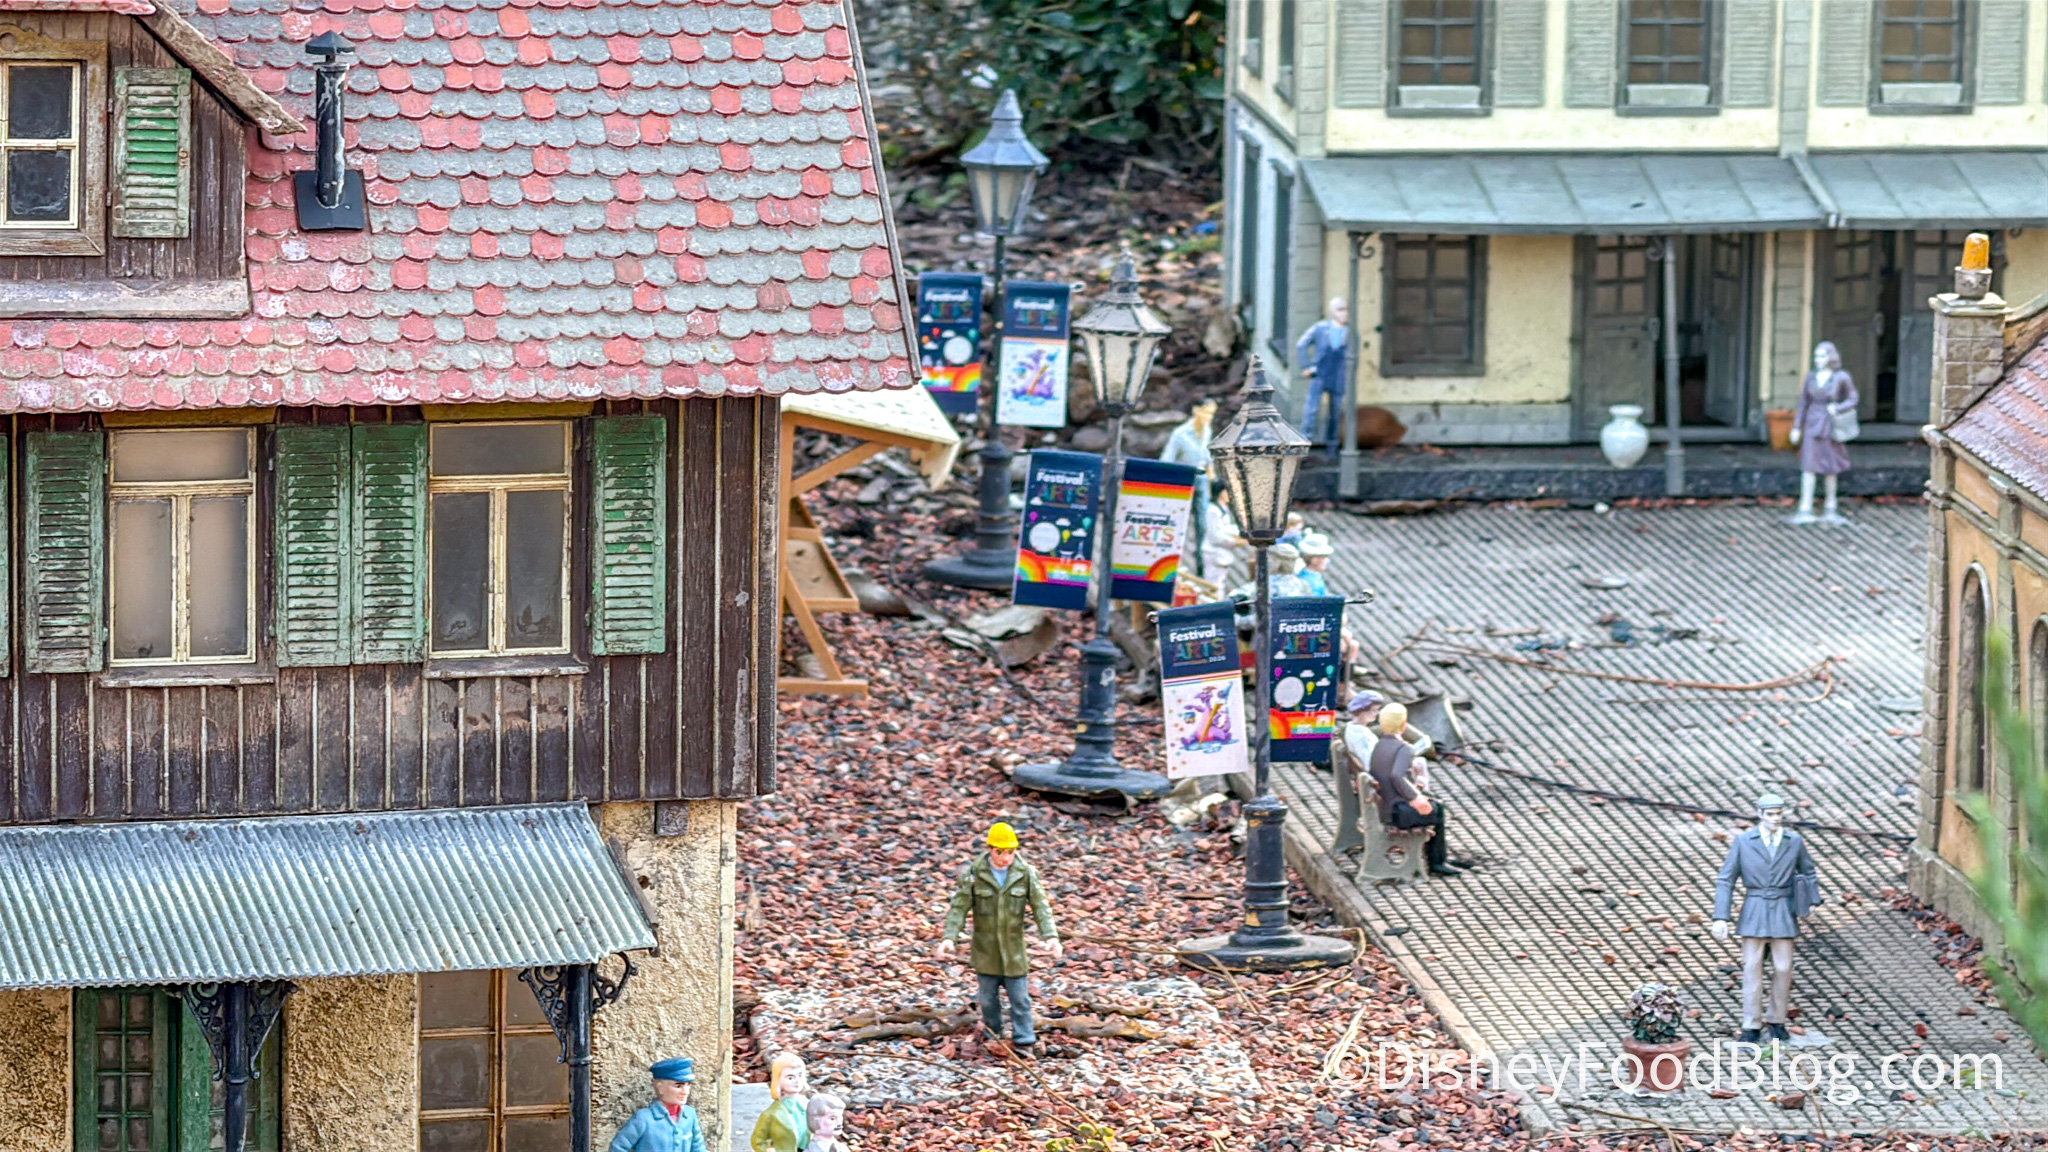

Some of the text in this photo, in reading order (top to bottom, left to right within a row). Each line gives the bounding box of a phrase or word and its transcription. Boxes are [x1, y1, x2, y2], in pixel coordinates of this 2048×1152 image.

[1036, 472, 1084, 485] Festival
[1037, 484, 1088, 504] ARTS
[1124, 515, 1170, 526] Festival
[1122, 525, 1174, 543] ARTS
[1170, 624, 1216, 642] Festival
[1279, 617, 1325, 633] Festival
[1173, 638, 1226, 661] ARTS
[1280, 632, 1331, 653] ARTS
